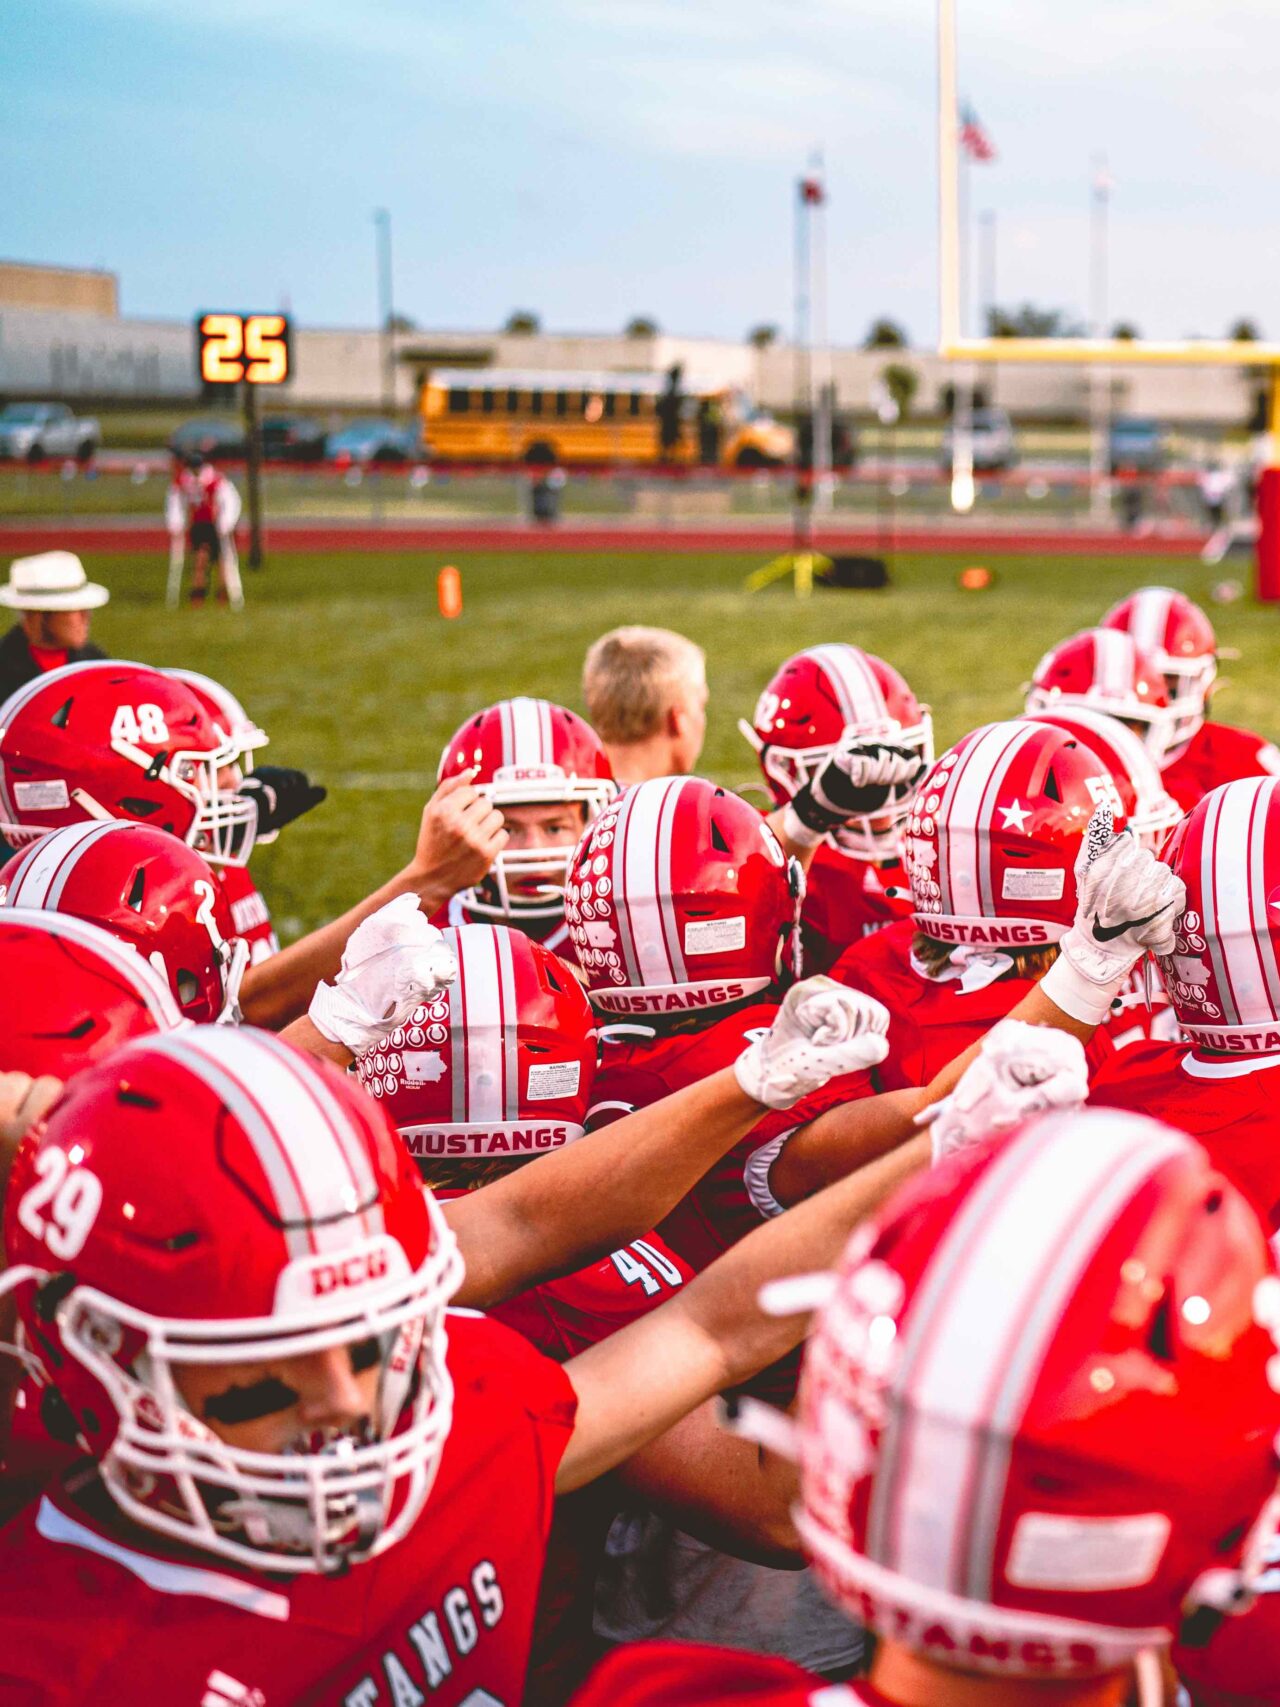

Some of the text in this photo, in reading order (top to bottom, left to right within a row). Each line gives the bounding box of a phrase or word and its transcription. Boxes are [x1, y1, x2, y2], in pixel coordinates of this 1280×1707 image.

[200, 314, 287, 384] 25
[110, 703, 170, 744] 48
[914, 917, 1048, 944] MUSTANGS
[597, 983, 744, 1013] MUSTANGS
[401, 1126, 568, 1155] MUSTANGS
[17, 1144, 104, 1261] 29
[609, 1239, 683, 1296] 40
